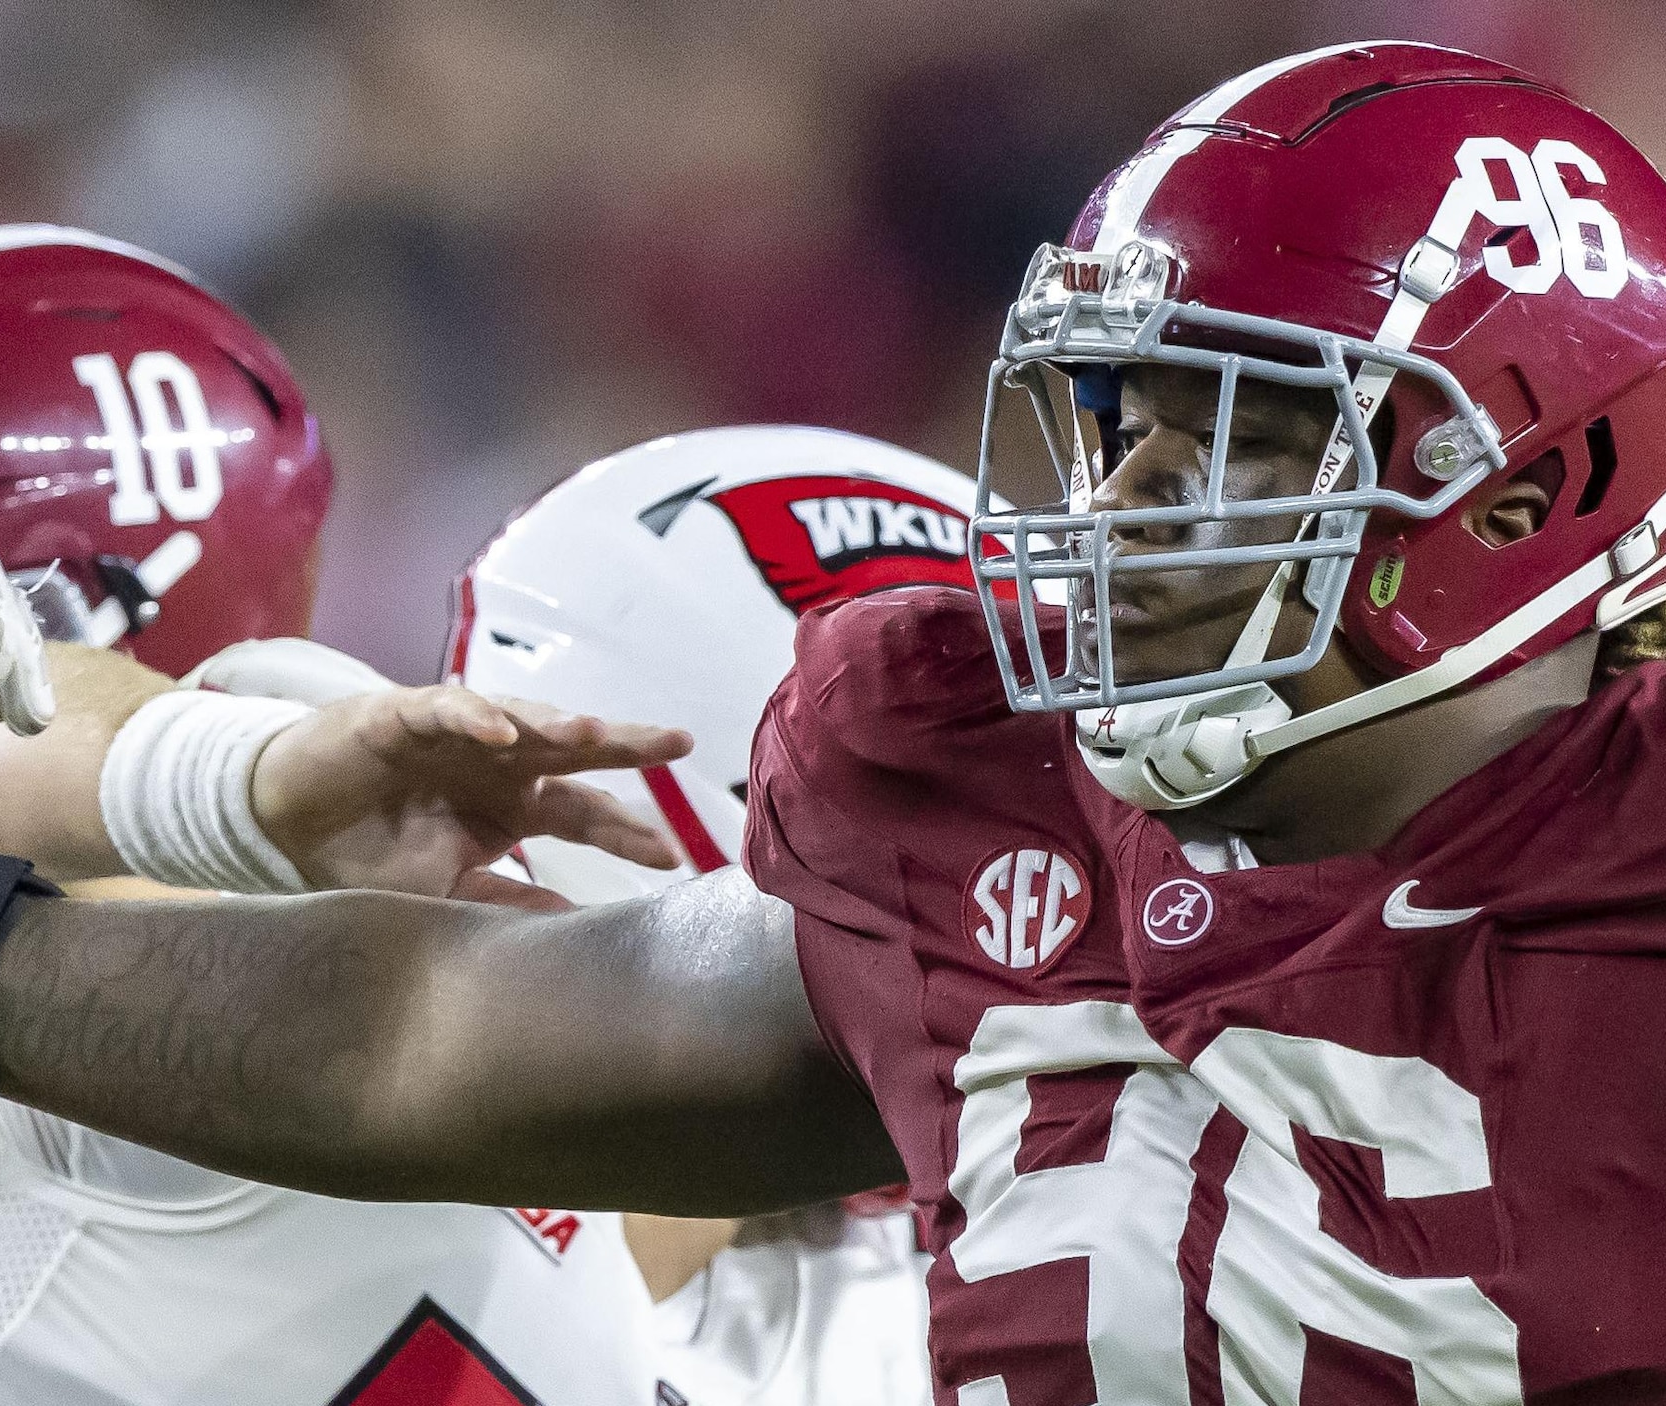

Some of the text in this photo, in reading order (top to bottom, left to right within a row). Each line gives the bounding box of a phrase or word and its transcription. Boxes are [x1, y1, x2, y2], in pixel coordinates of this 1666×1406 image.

[1454, 136, 1629, 299] 96
[73, 350, 224, 525] 10
[788, 496, 968, 560] WKU
[974, 848, 1082, 969] SEC
